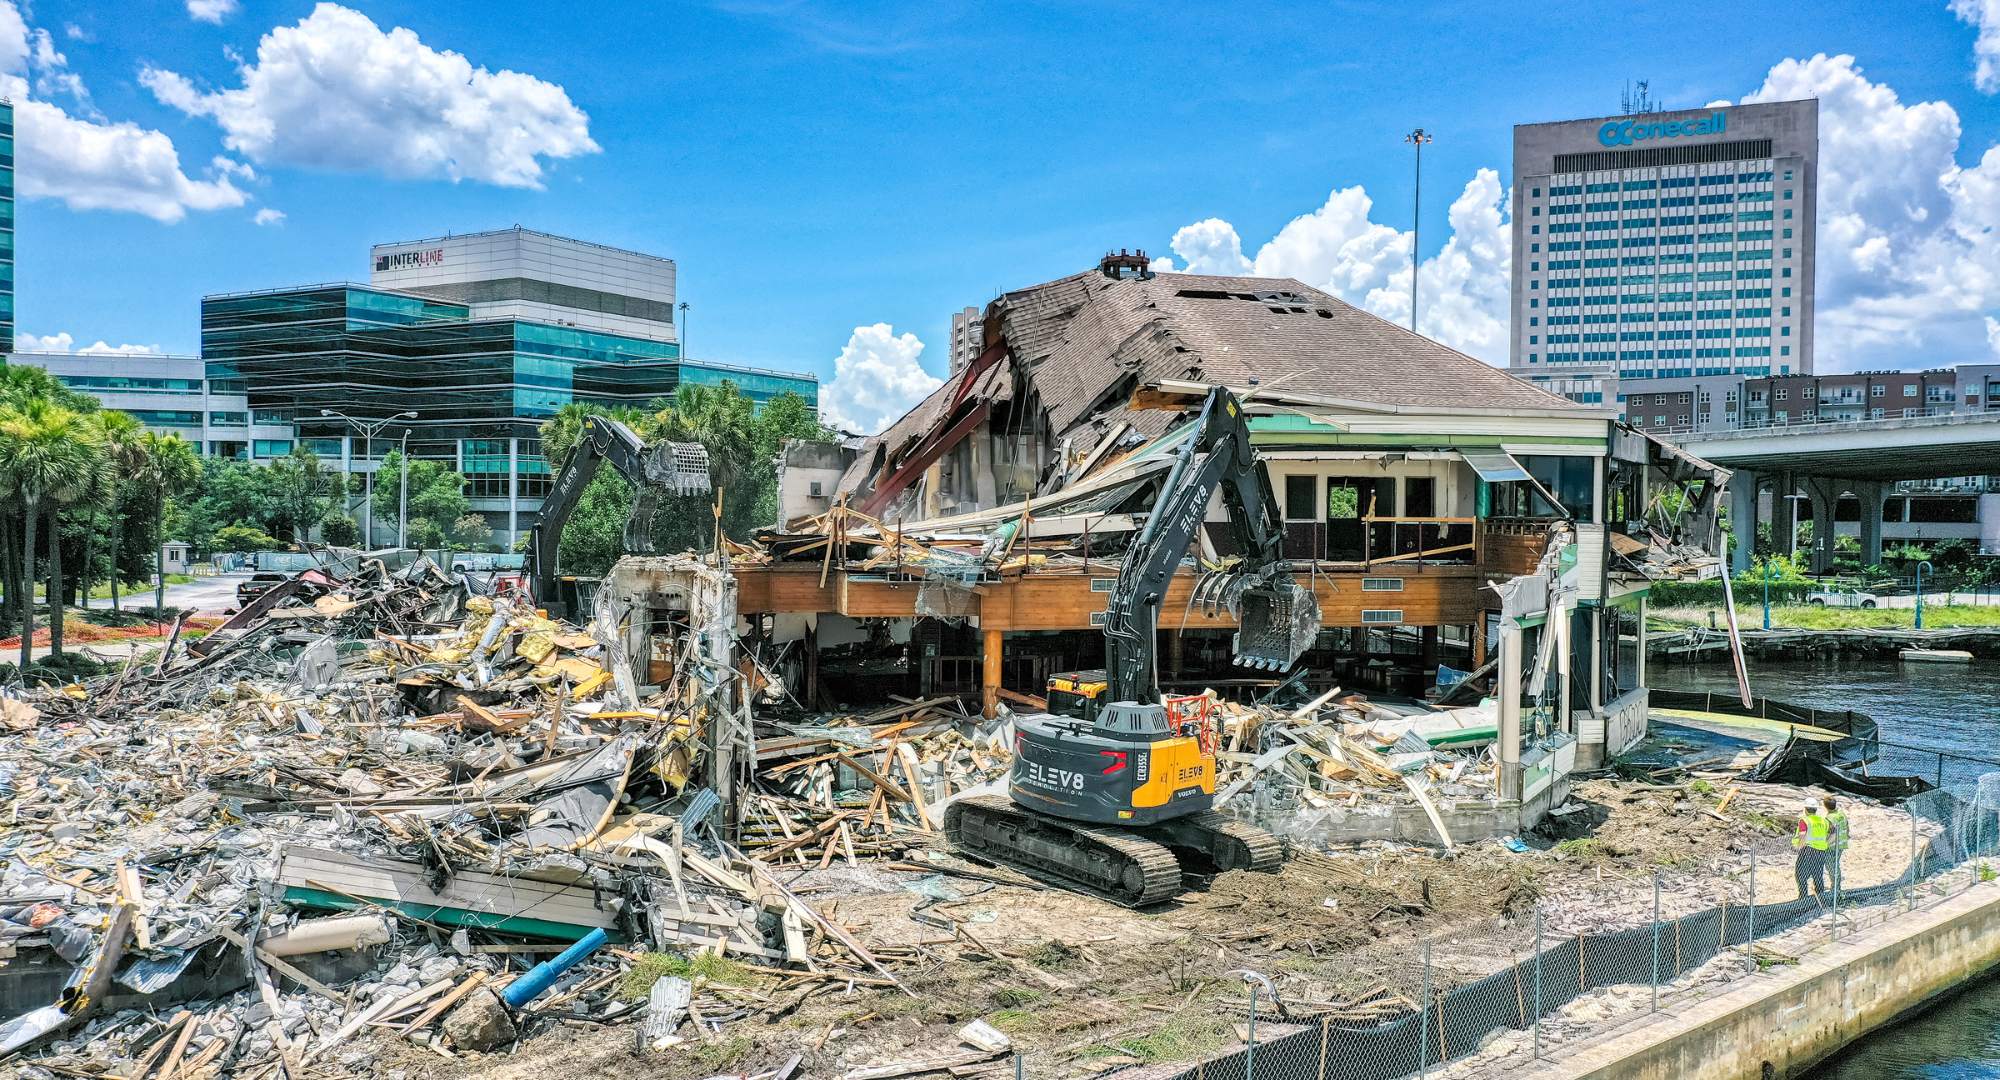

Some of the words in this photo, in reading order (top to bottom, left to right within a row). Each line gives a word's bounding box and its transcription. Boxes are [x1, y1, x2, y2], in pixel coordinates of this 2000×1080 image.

[390, 250, 443, 267] INTERLINE
[1180, 485, 1207, 533] ELEV8
[1029, 762, 1084, 790] ELEV8
[1179, 765, 1203, 780] ELEV8
